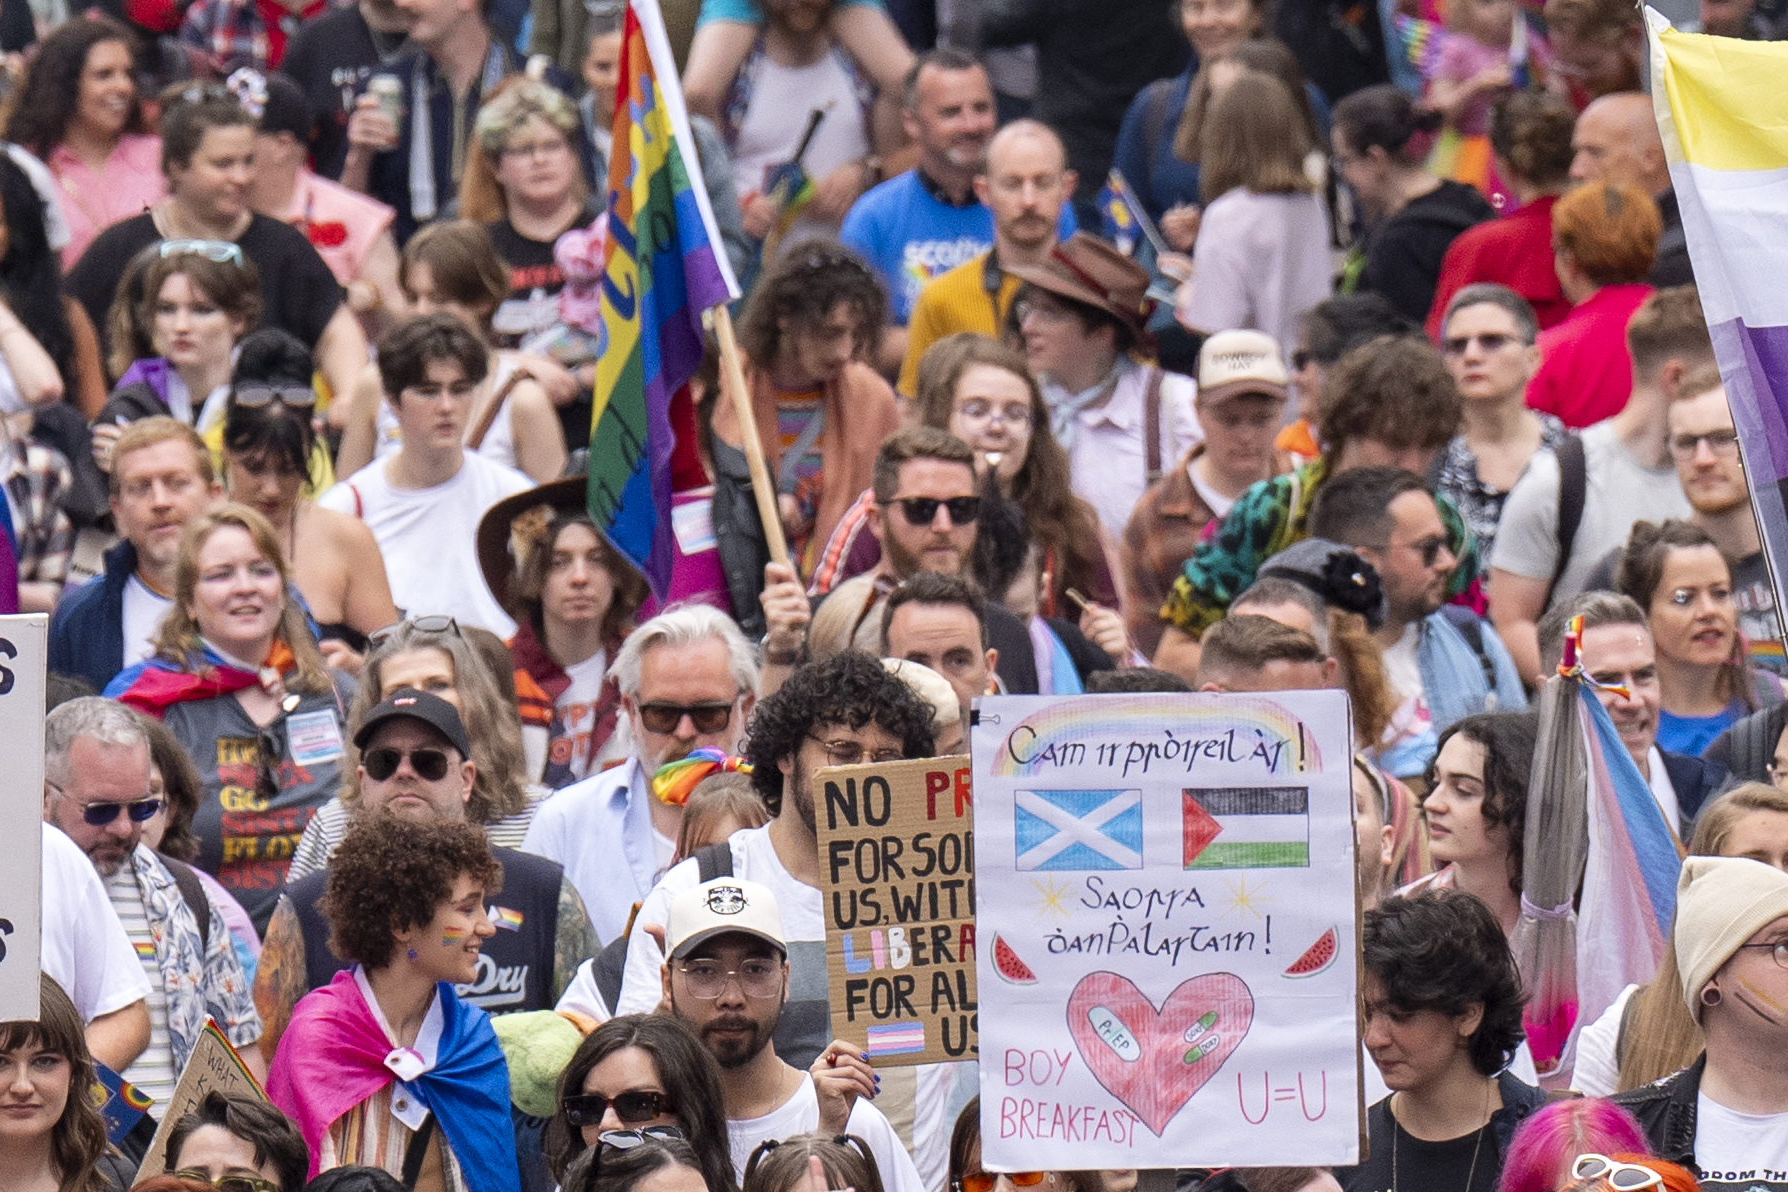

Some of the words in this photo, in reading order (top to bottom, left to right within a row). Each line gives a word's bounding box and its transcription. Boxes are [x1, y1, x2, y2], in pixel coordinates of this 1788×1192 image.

[824, 775, 892, 830] NO
[926, 768, 972, 820] PR
[829, 835, 905, 884] FOR
[832, 887, 890, 930] US,
[842, 924, 975, 974] LIBERA
[845, 974, 919, 1022] FOR
[931, 969, 977, 1016] AL
[208, 1046, 240, 1089] WHAT
[1004, 1049, 1072, 1087] BOY
[1000, 1097, 1140, 1148] BREAKFAST
[1237, 1070, 1327, 1125] U=U
